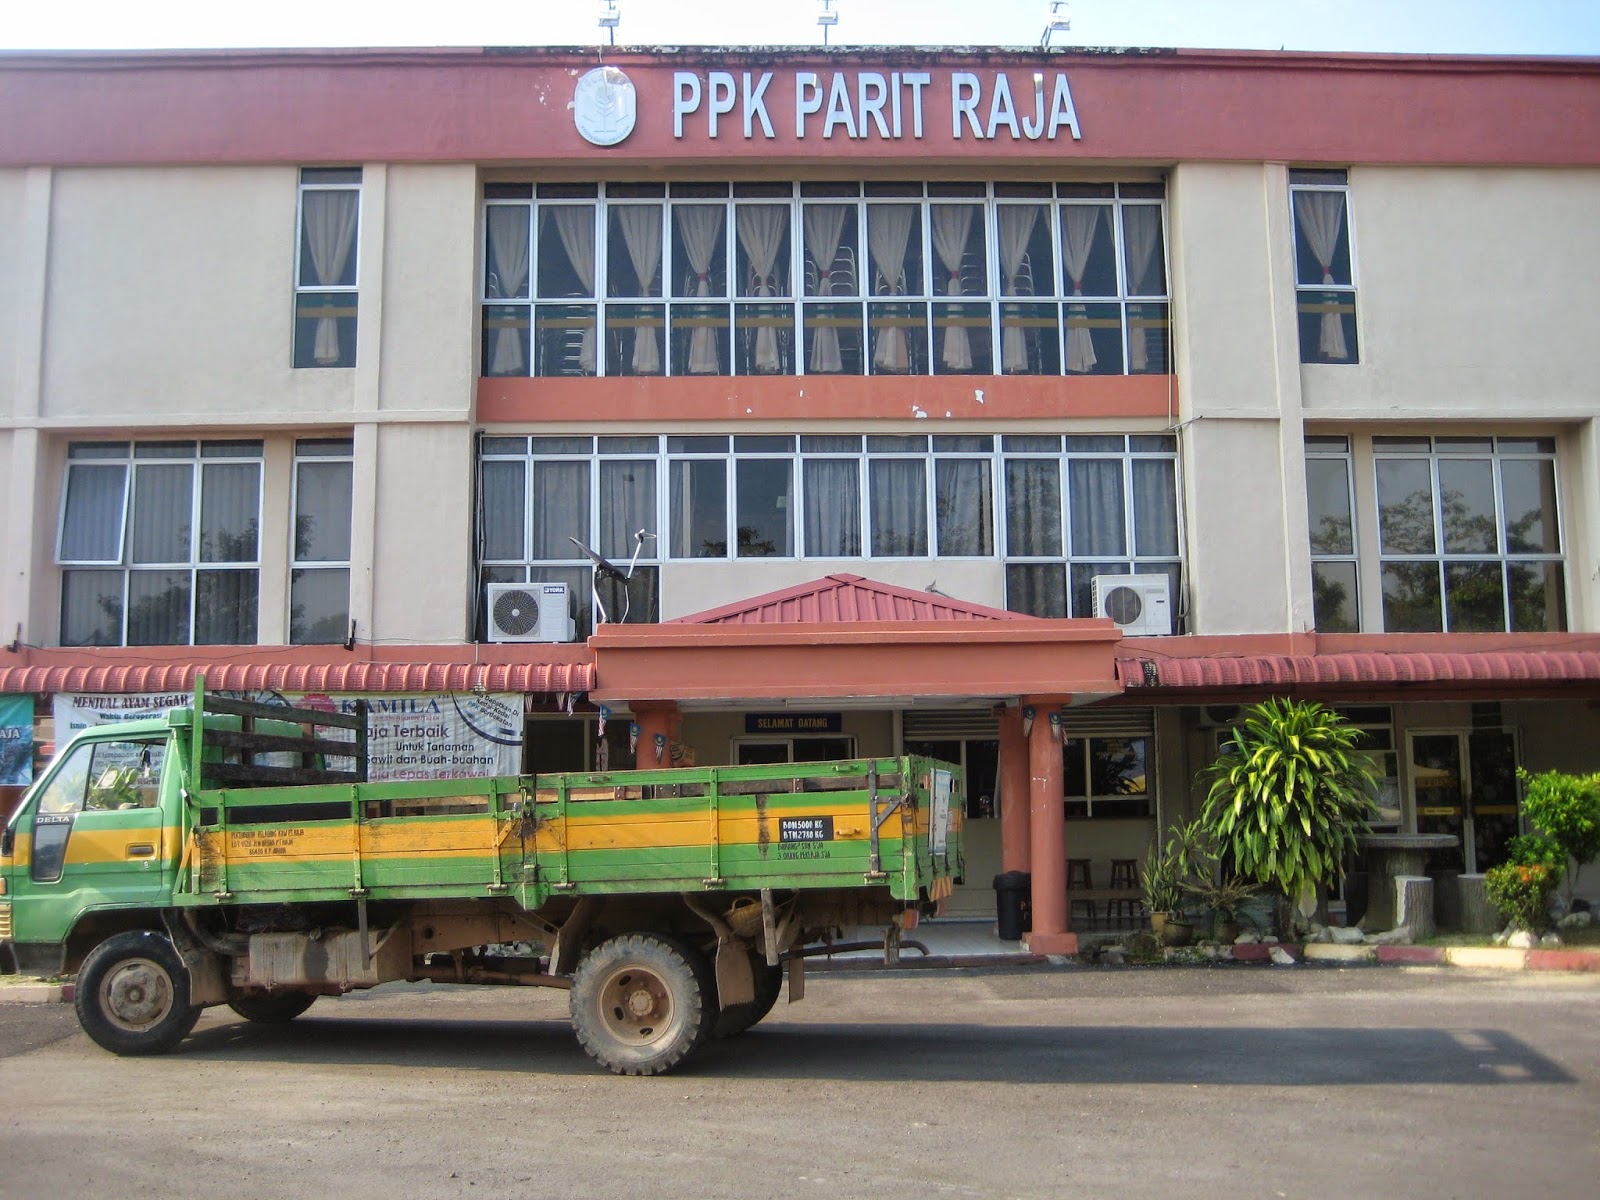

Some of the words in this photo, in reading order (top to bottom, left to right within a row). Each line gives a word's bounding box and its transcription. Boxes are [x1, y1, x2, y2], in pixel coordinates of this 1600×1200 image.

[673, 71, 775, 139] PPK
[796, 71, 930, 140] PARIT
[951, 72, 1081, 140] RAJA
[72, 696, 119, 709] MENJUAL
[121, 696, 151, 709] AYAM
[467, 700, 480, 710] PPK
[99, 712, 121, 720] Waktu
[123, 712, 162, 720] Beroperasi
[512, 709, 520, 717] Di
[757, 718, 794, 729] SELAMAT
[798, 717, 828, 728] DATANG
[366, 726, 388, 740] aja
[393, 724, 450, 738] Terbaik
[396, 742, 424, 751] Untuk
[427, 742, 475, 751] Tanaman
[366, 754, 394, 764] Sawit
[396, 754, 417, 764] dan
[420, 754, 494, 765] Buah-buahan
[369, 770, 389, 780] aja
[37, 815, 70, 823] DELTA
[814, 819, 824, 829] KG
[814, 830, 824, 839] KG
